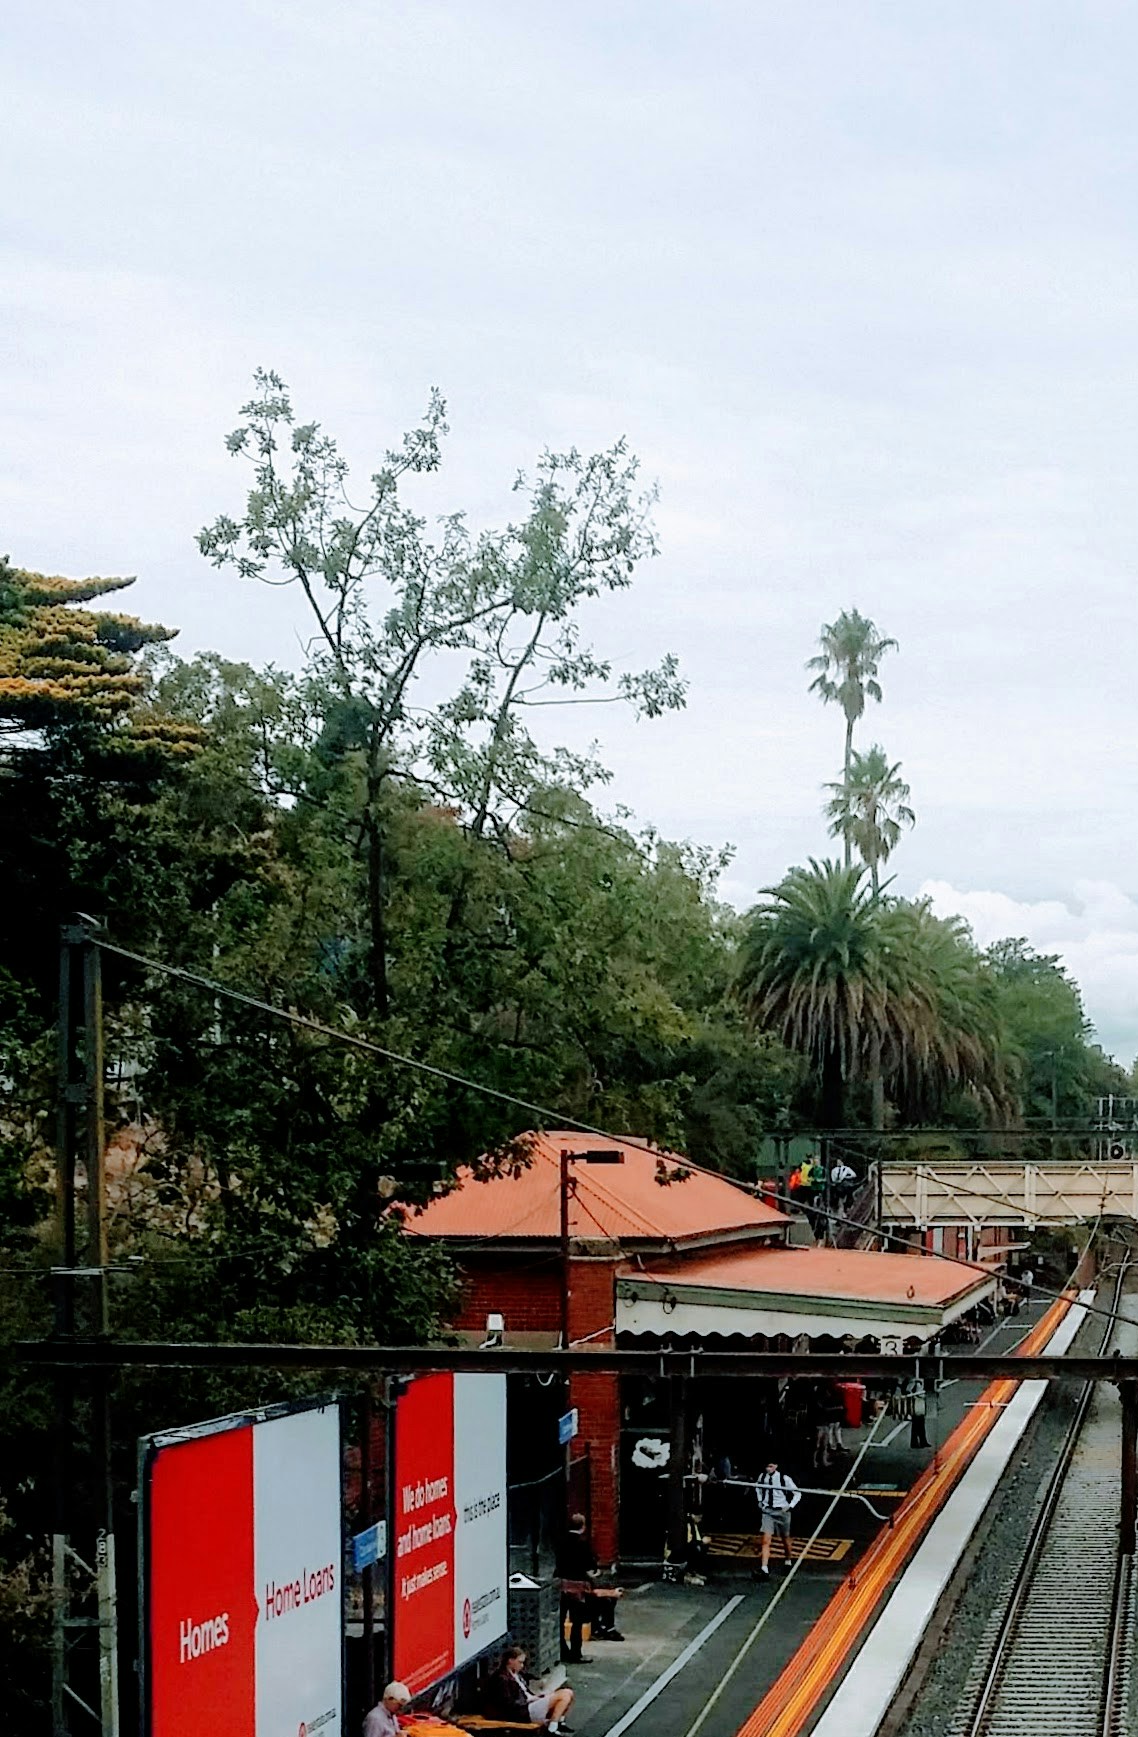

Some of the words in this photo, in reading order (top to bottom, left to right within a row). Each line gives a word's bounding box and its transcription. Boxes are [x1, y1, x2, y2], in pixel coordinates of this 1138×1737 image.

[885, 1340, 898, 1355] 3
[266, 1580, 301, 1621] Home
[303, 1563, 335, 1604] Loans
[180, 1612, 229, 1664] Homes
